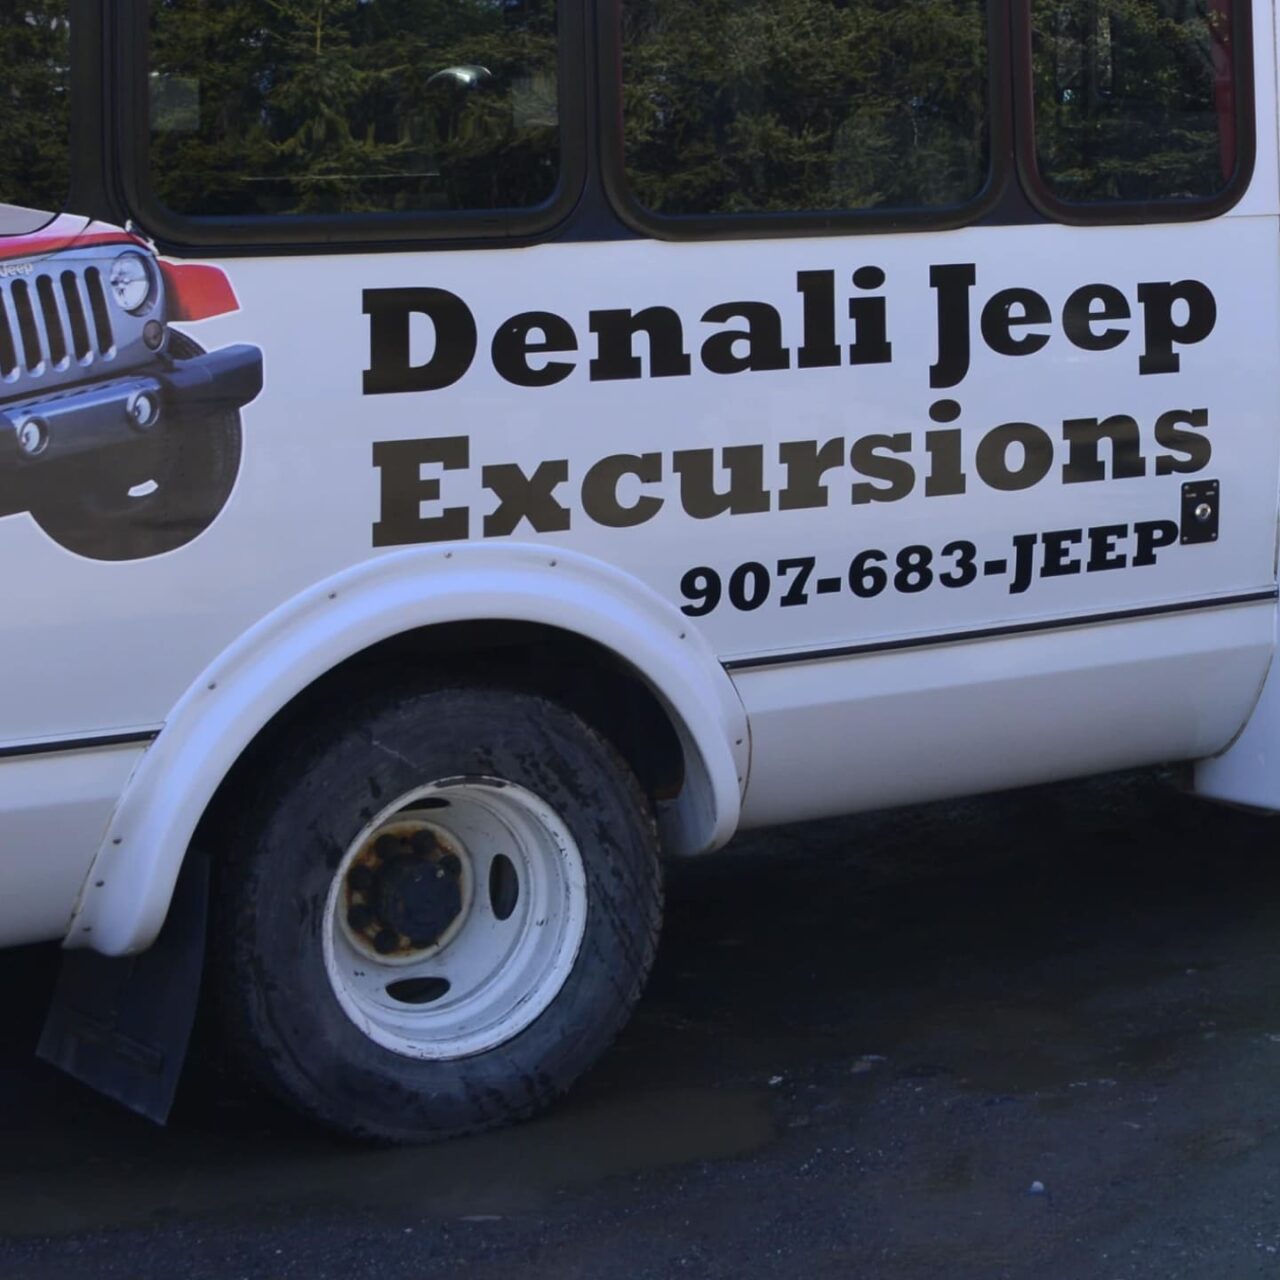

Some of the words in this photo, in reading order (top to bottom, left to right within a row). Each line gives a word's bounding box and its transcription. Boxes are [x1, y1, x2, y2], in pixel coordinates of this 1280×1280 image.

[362, 265, 892, 396] Denali
[929, 262, 1217, 389] Jeep
[372, 398, 1212, 548] Excursions
[680, 519, 1179, 617] 907-683-JEEP
